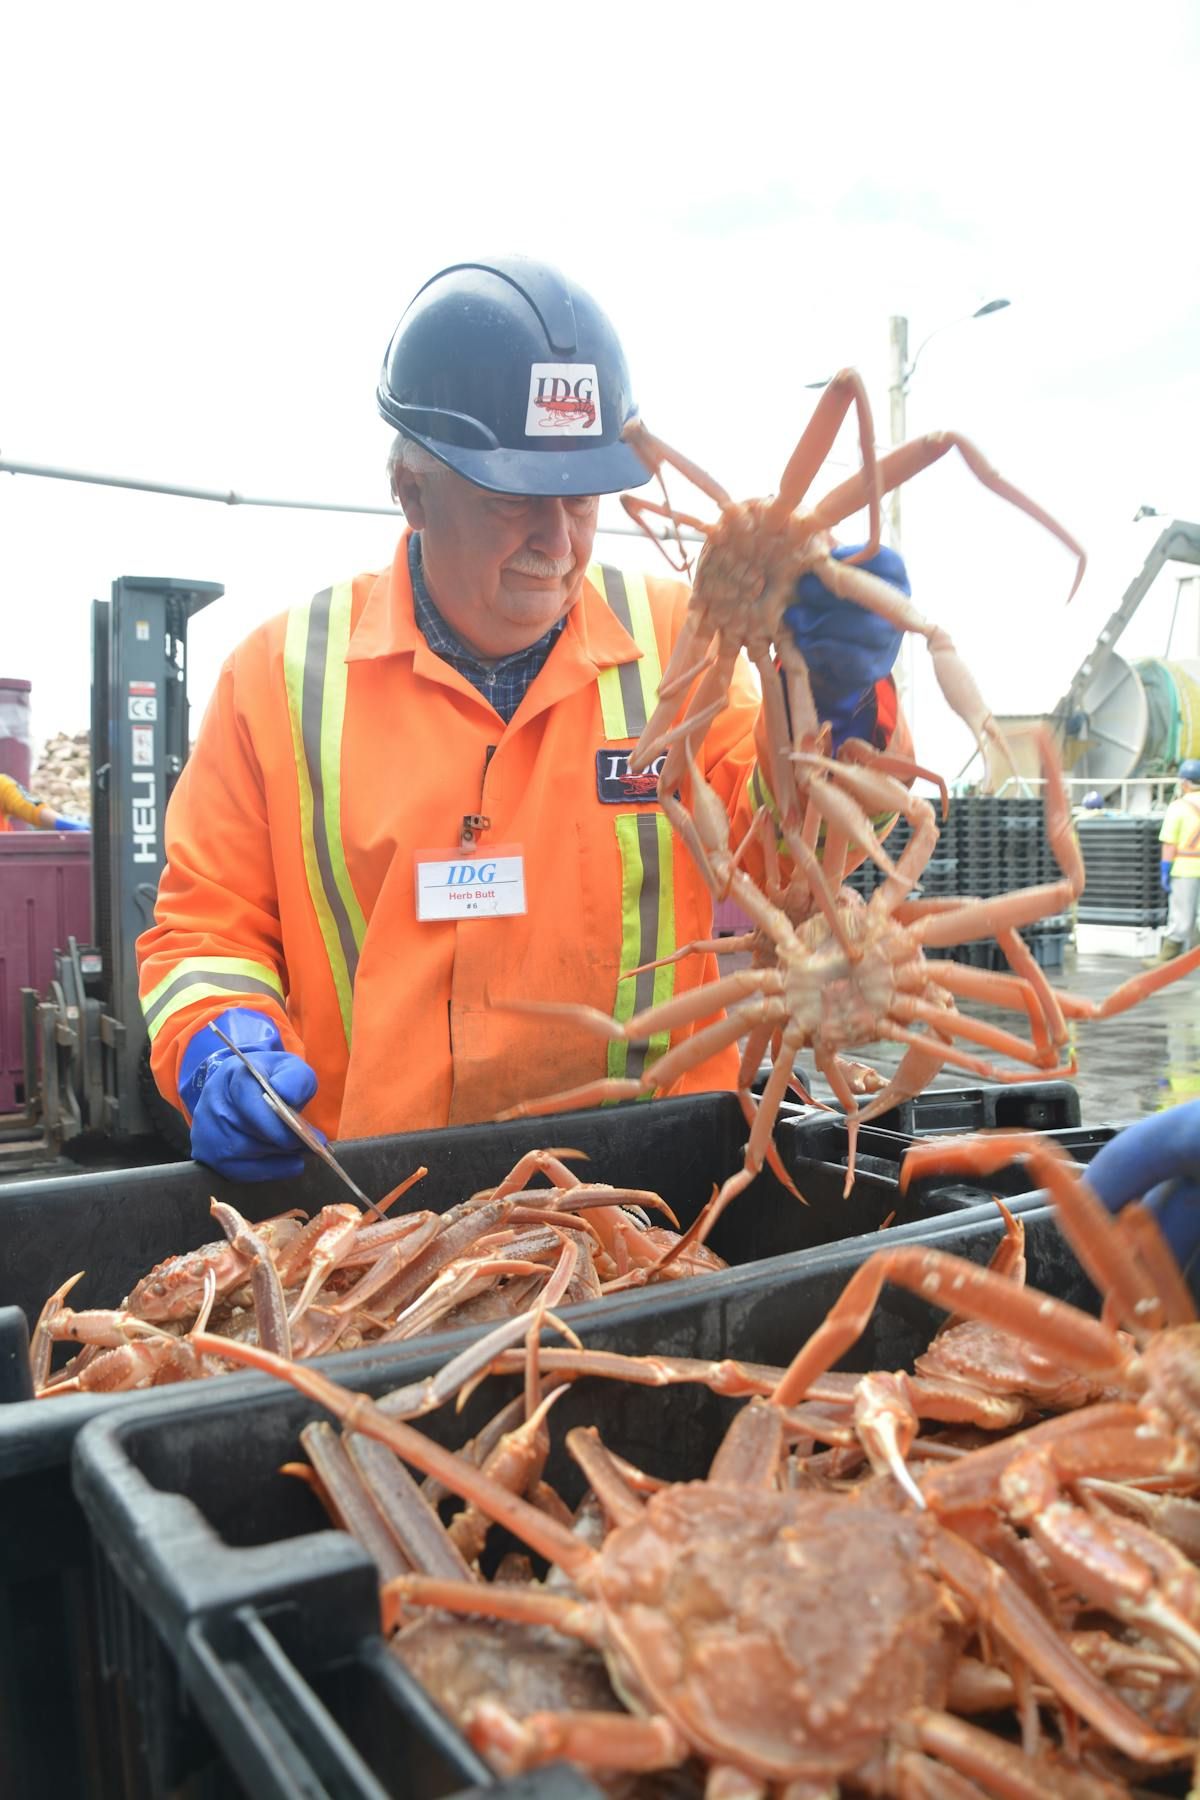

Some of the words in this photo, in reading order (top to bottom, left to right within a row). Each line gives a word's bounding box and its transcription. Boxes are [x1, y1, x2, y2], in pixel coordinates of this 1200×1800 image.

[535, 377, 593, 403] IDG
[131, 700, 154, 717] CE
[132, 772, 157, 863] HELI
[447, 863, 497, 885] IDG
[449, 892, 472, 900] Herb
[475, 890, 496, 899] Butt
